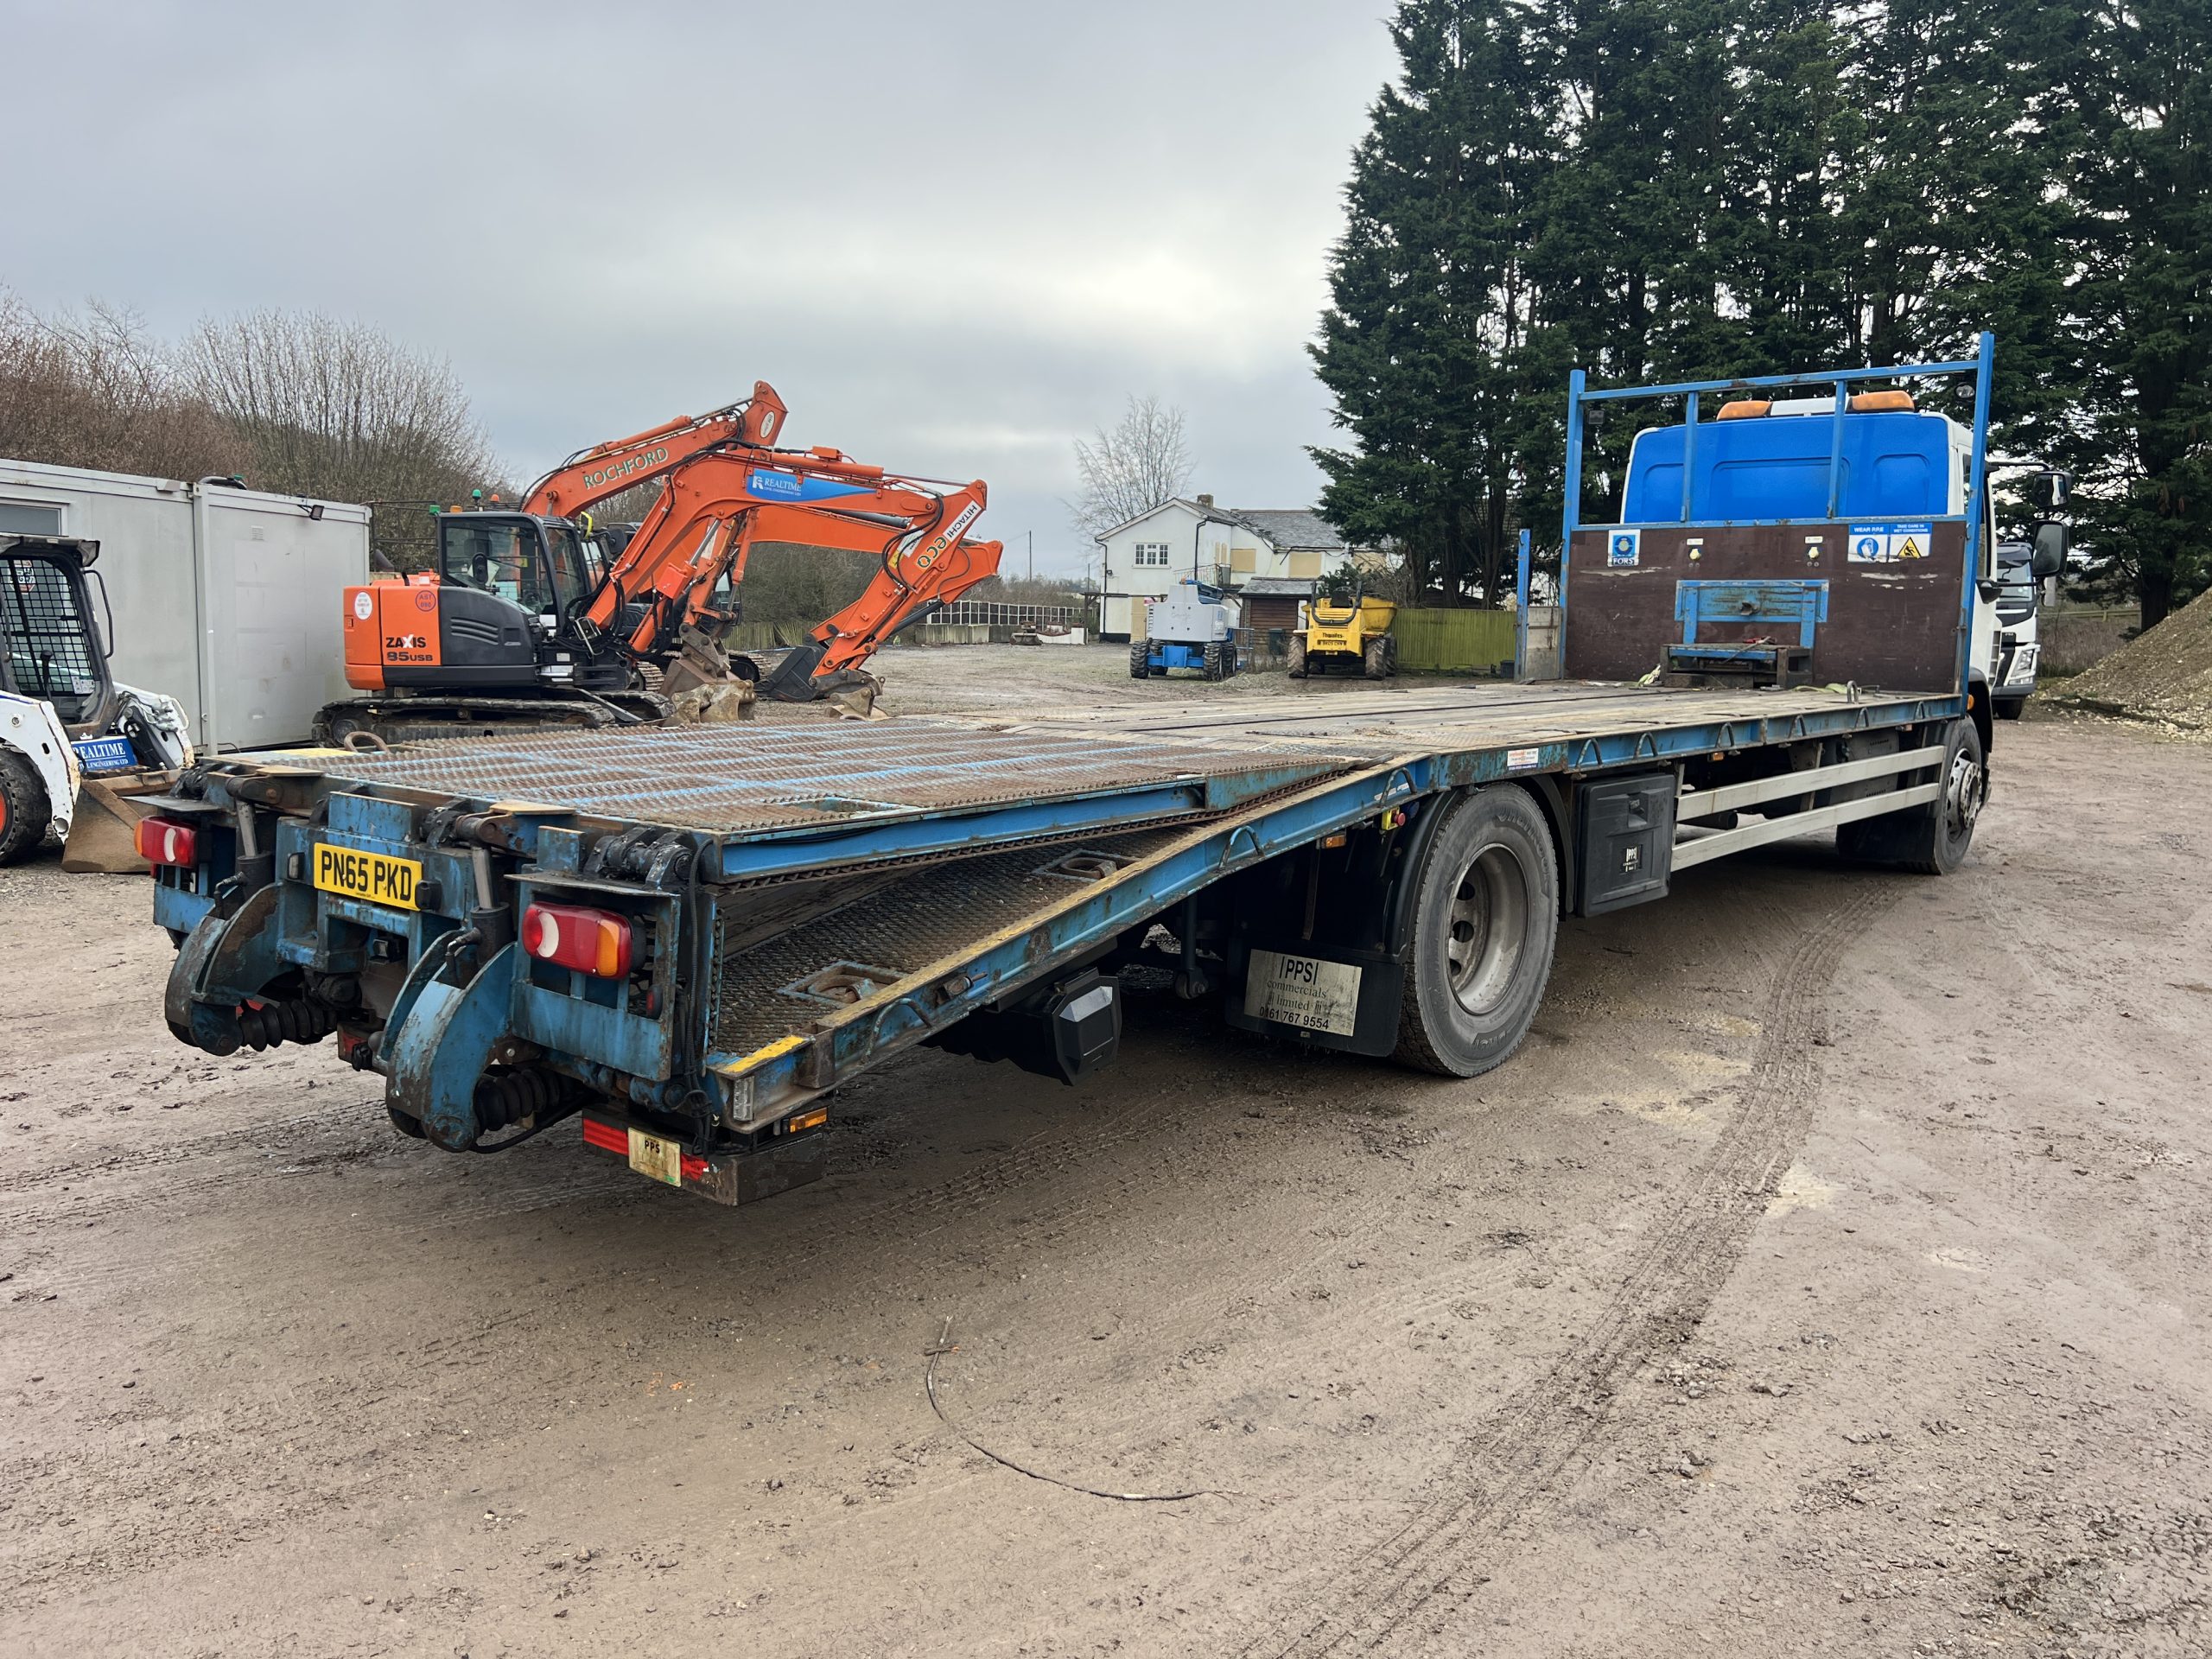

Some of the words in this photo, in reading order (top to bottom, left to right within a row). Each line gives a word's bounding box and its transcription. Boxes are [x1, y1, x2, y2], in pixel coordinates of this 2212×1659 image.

[582, 447, 669, 491] ROCHFORD
[764, 477, 802, 493] REALTIME
[946, 504, 978, 538] HITACHI
[917, 536, 947, 569] eco
[385, 634, 427, 649] ZAXIS
[386, 652, 434, 662] 85USB
[321, 850, 369, 892] PN65
[374, 861, 412, 902] PKD
[1267, 980, 1327, 999] commercials
[1277, 995, 1310, 1011] limited
[1259, 1006, 1280, 1020] 0161
[1283, 1011, 1300, 1024] 767
[1303, 1015, 1329, 1030] 9554
[644, 1140, 660, 1154] PPS
